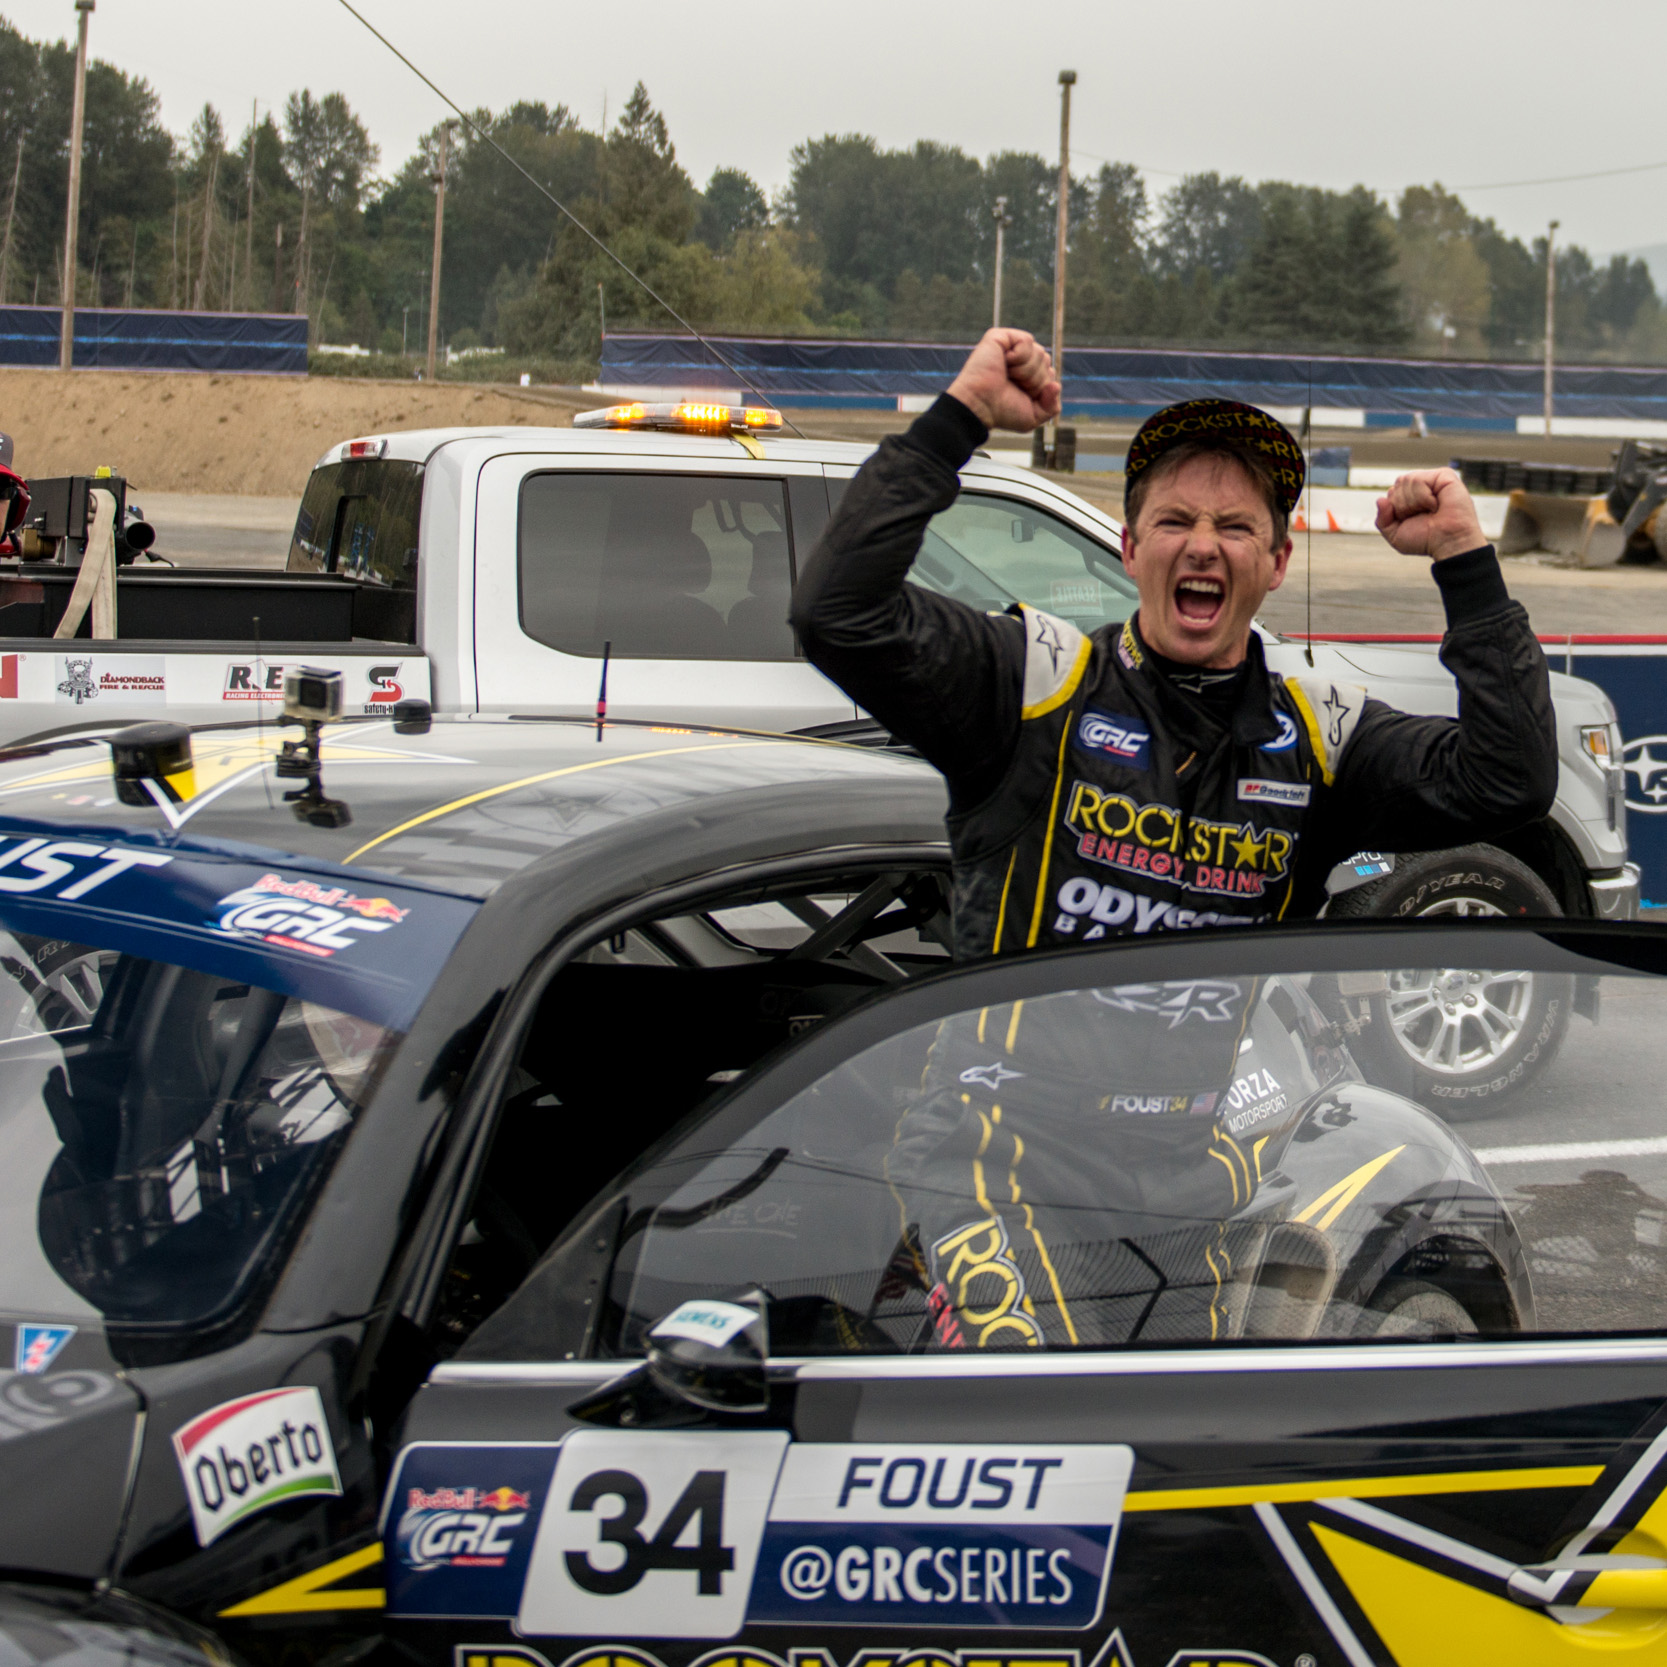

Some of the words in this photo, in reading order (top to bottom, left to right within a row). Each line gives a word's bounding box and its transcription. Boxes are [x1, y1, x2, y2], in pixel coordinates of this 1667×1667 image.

[100, 672, 165, 684] DIAMONDBACK
[1084, 721, 1150, 752] GRC
[1081, 832, 1185, 880] ENERGY
[1196, 865, 1268, 894] DRINK
[222, 899, 394, 950] GRC
[1431, 999, 1559, 1099] WRANGLER
[1227, 1068, 1281, 1109] ORZA
[1228, 1093, 1288, 1134] MOTORSPORT
[193, 1419, 323, 1512] Oberto
[836, 1457, 1063, 1510] FOUST
[414, 1512, 528, 1560] GRC
[563, 1469, 736, 1597] 34
[780, 1545, 1074, 1605] @GRCSERIES
